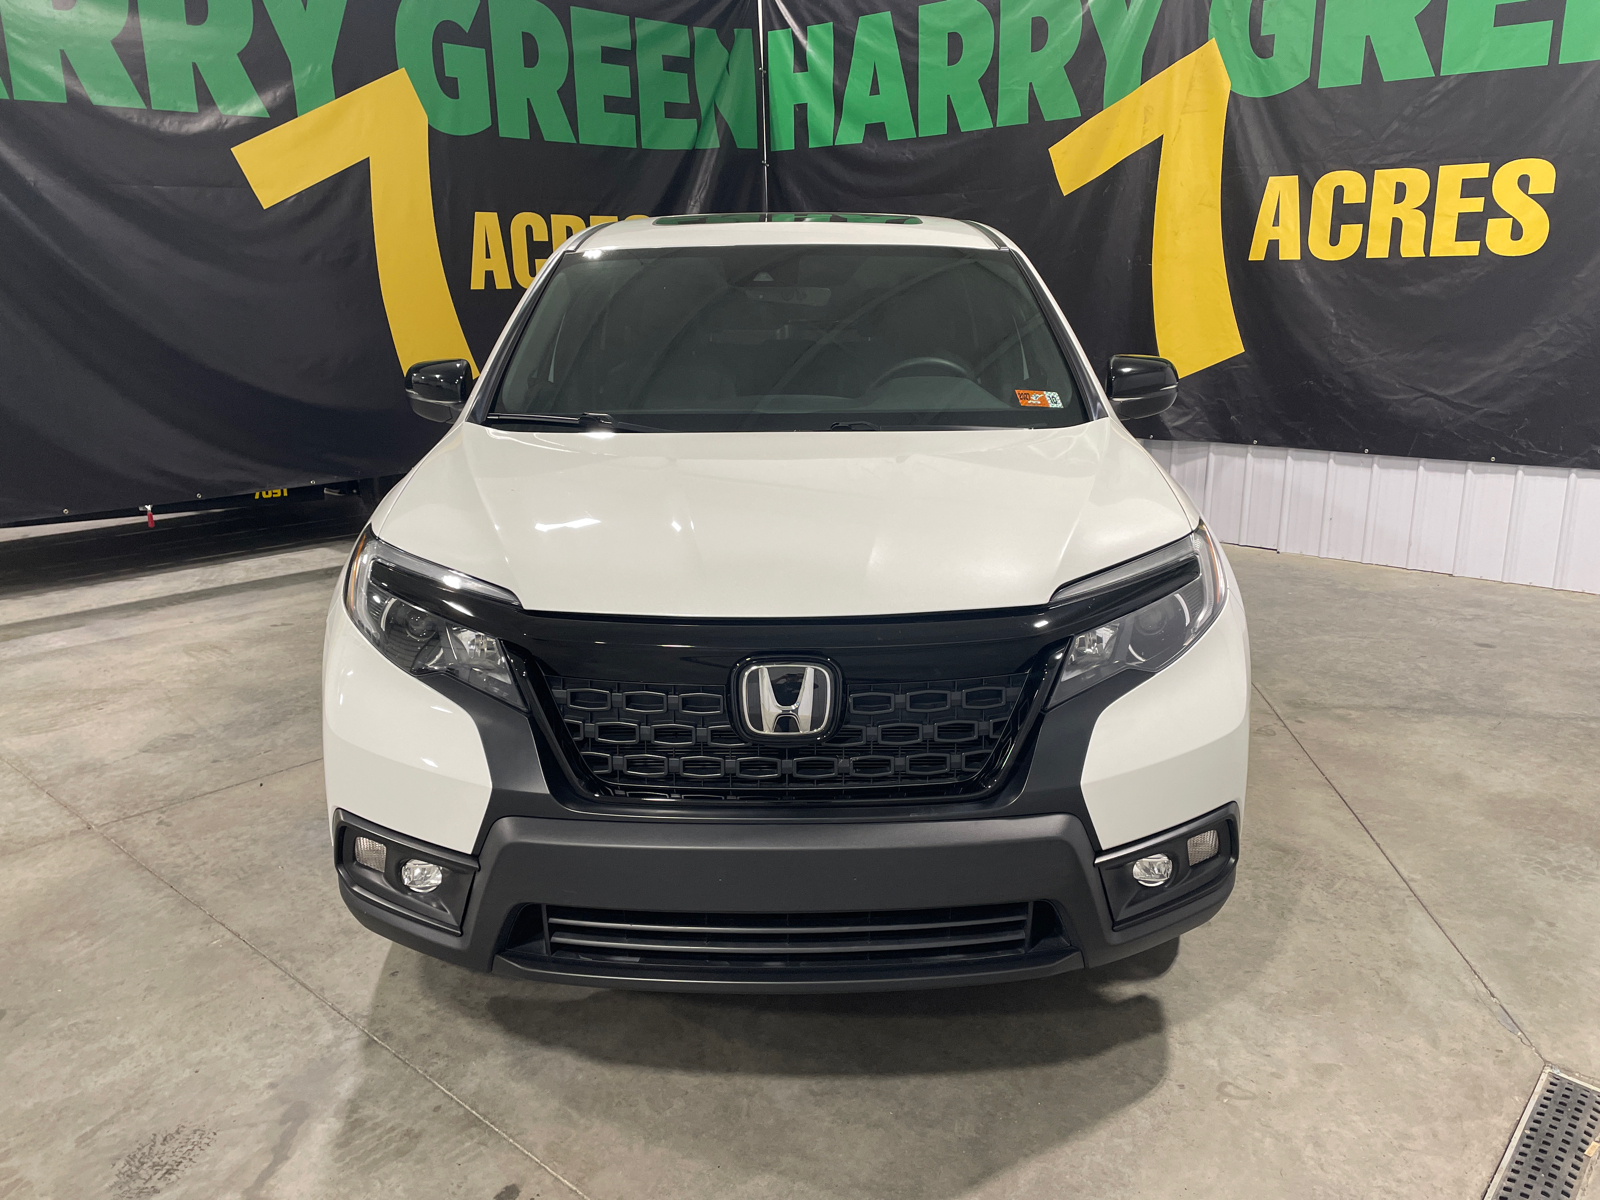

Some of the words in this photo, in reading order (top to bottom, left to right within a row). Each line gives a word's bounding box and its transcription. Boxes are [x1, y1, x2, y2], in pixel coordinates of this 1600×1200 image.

[0, 0, 347, 118] RRY
[395, 0, 758, 151] GREEN
[768, 0, 1163, 152] HARRY
[230, 67, 480, 380] 7
[1048, 37, 1245, 378] 7
[1248, 158, 1556, 261] ACRES
